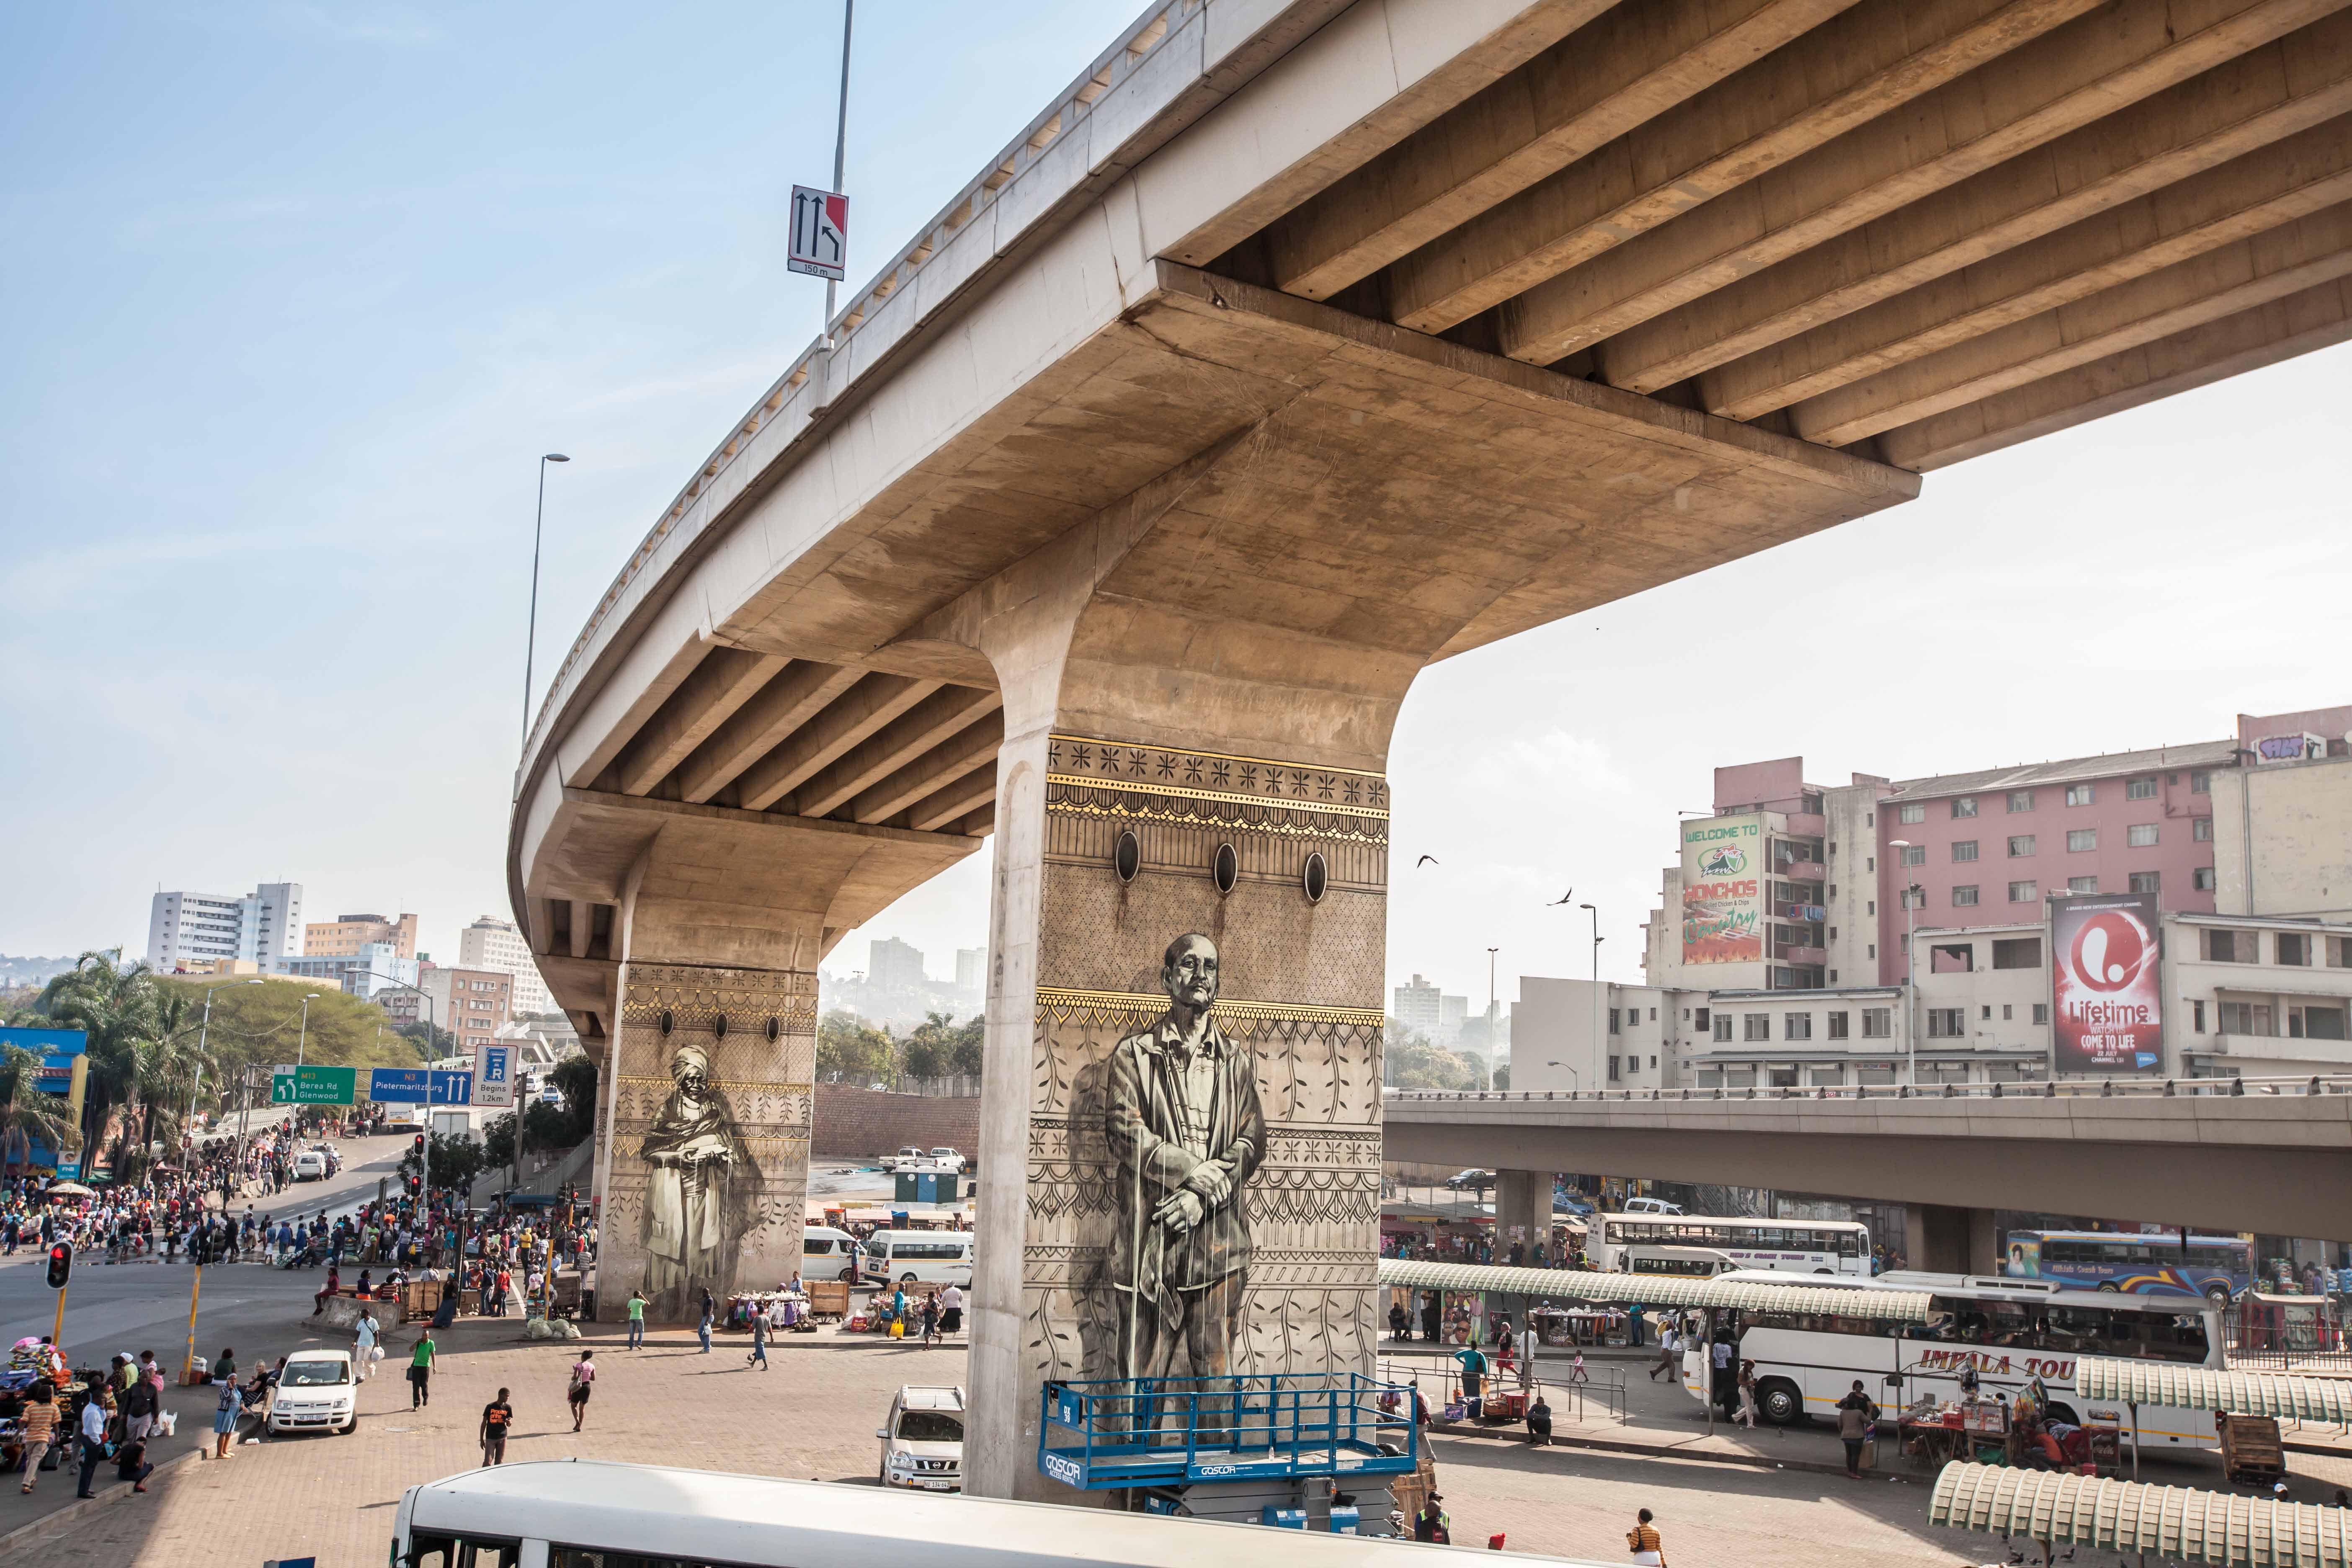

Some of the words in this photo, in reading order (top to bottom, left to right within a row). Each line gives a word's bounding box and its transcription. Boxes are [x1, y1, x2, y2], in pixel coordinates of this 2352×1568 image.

[804, 264, 818, 273] 150
[1685, 827, 1739, 843] WELCOME
[1742, 824, 1758, 836] TO
[1685, 879, 1757, 902] HONCHOS
[1685, 907, 1758, 944] Country
[2069, 1000, 2148, 1022] Lifetime
[2081, 1035, 2103, 1048] COME
[2105, 1035, 2116, 1048] TO
[2118, 1034, 2135, 1048] LIFE
[493, 1068, 502, 1079] R
[481, 1084, 506, 1093] Begins
[2025, 1357, 2076, 1380] TOU
[1064, 1406, 1070, 1415] DX
[1064, 1414, 1070, 1423] 39
[1046, 1455, 1080, 1480] GOSCOR
[1201, 1466, 1236, 1475] GOSCOR
[1049, 1470, 1062, 1480] ACCESS
[1062, 1474, 1075, 1485] RENTAL
